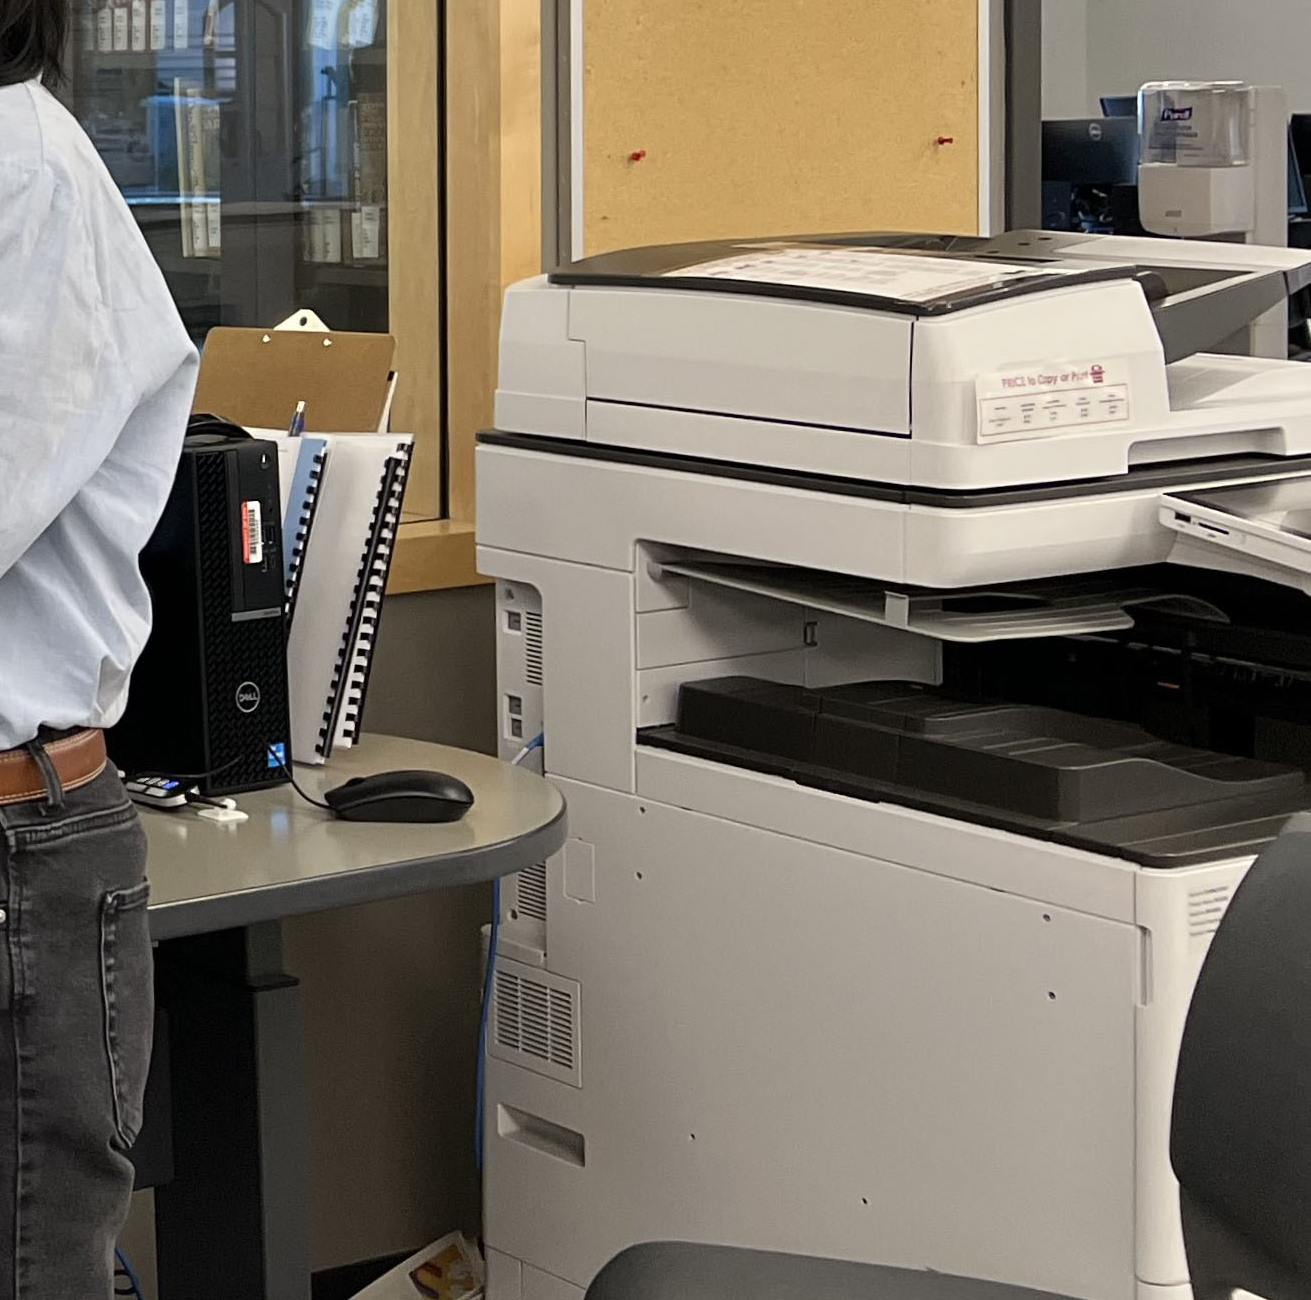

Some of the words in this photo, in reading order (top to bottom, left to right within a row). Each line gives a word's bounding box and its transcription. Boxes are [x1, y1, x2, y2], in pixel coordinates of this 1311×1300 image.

[1001, 377, 1026, 388] PRICE
[1038, 374, 1057, 386] Copy
[239, 692, 257, 702] DELL
